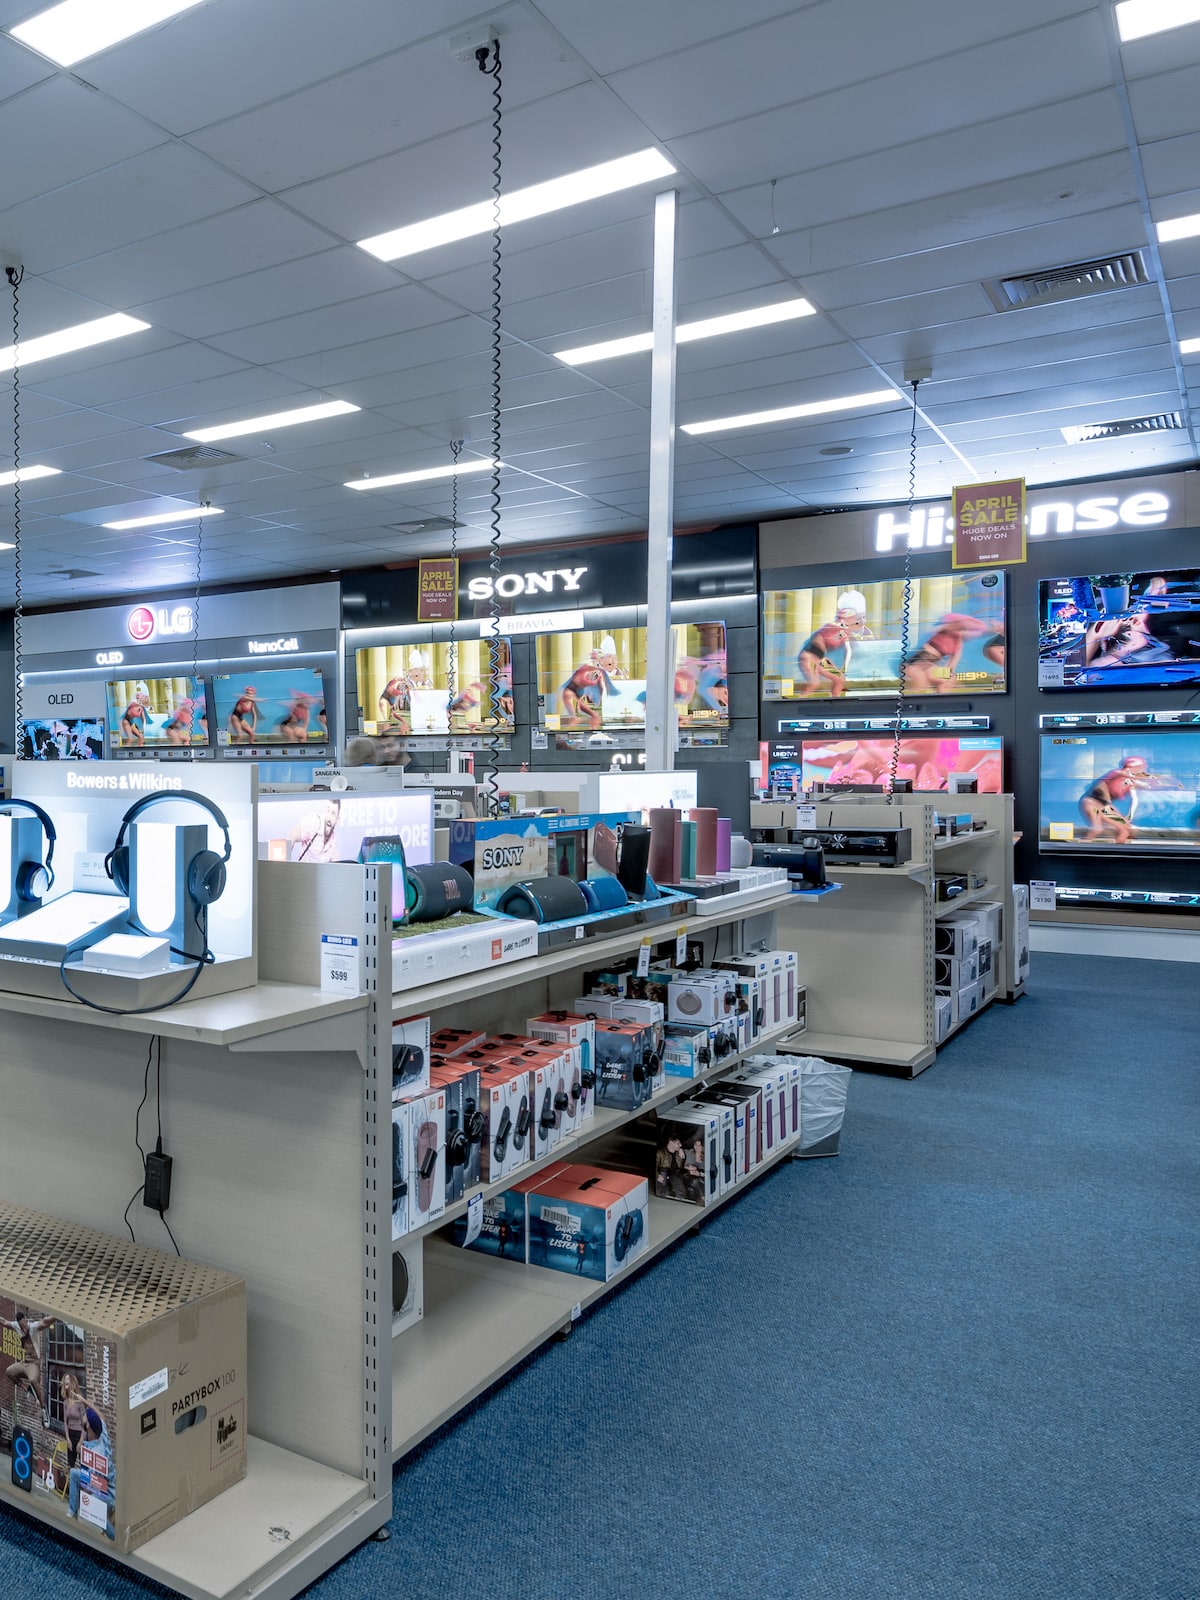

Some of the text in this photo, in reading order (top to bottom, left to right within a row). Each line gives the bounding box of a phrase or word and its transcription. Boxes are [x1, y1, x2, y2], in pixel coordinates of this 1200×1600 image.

[960, 495, 1019, 513] APRIL
[875, 491, 1170, 552] Hinse
[960, 507, 1019, 527] SALE
[962, 523, 1016, 535] HUGE DEALS
[970, 532, 1008, 542] NOW ON
[422, 571, 454, 581] APRIL
[468, 567, 588, 600] SONY
[422, 580, 454, 592] SALE
[159, 606, 193, 635] LG
[507, 618, 555, 630] BRAVIA
[248, 637, 299, 654] NanoCell
[96, 651, 124, 665] OLED
[47, 693, 75, 706] OLED
[66, 771, 183, 790] Bowers & Wilkins
[452, 790, 464, 798] Day
[340, 800, 397, 826] FREE TO
[482, 846, 524, 870] SONY
[330, 970, 348, 982] $599
[483, 1209, 500, 1219] ARE
[483, 1217, 495, 1225] TO
[561, 1234, 572, 1242] TO
[2, 1326, 23, 1346] BASS
[2, 1341, 26, 1361] BOOST
[171, 1378, 221, 1416] PARTYBOX
[222, 1369, 236, 1387] 100
